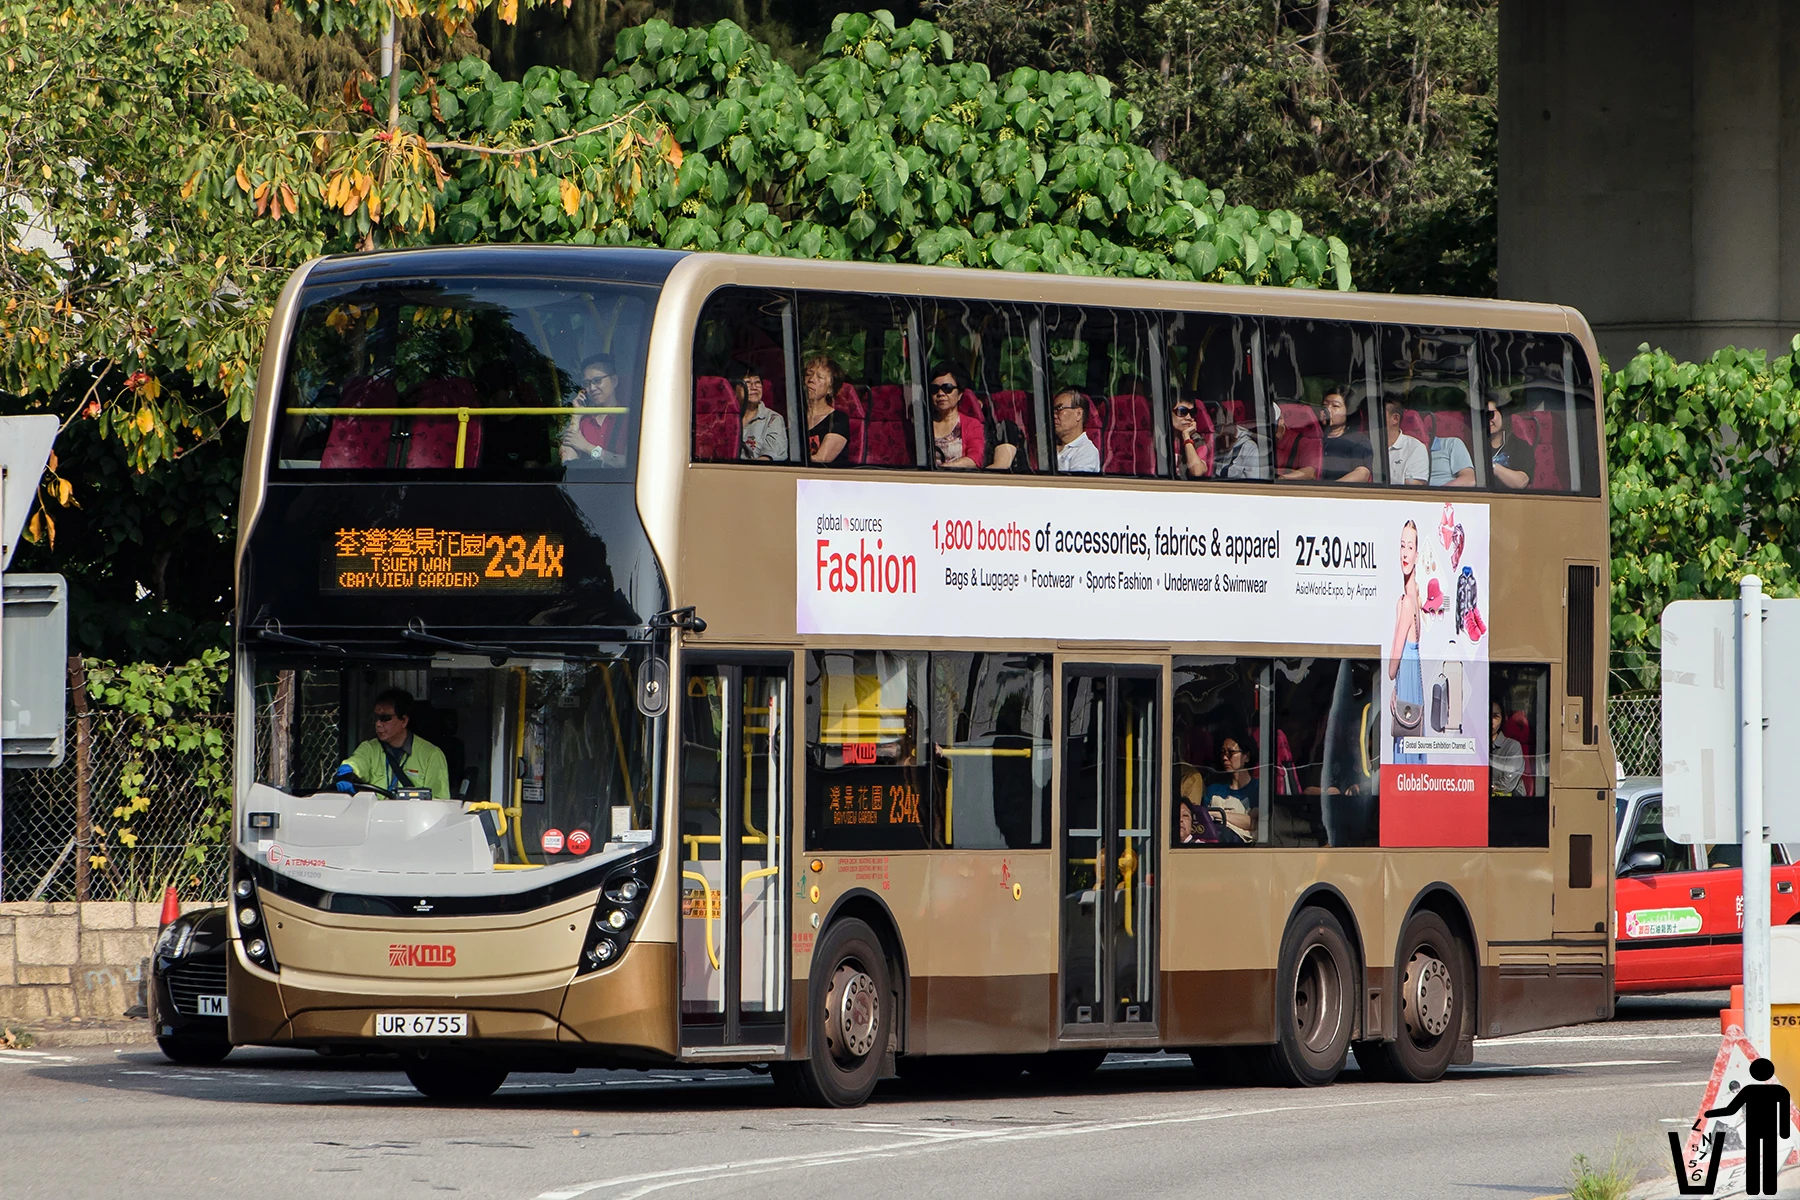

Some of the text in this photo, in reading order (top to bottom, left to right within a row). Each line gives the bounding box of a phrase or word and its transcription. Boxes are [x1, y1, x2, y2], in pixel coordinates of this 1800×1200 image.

[816, 513, 883, 535] global sources
[335, 528, 486, 557] 荃灣灣景花園
[932, 519, 1281, 565] 1,800 booths of accessories, fabrics & apparel
[1295, 535, 1377, 570] 27-30 APRIL
[371, 557, 451, 572] TSUEN WAN
[816, 538, 917, 594] Fashion
[339, 572, 480, 588] (BAYVIEW GARDEN)
[945, 568, 1268, 594] Bags & Luggage Footwear Sports Fashion Underwear & Swimwear
[1295, 581, 1377, 601] AsiaWorld-Expo, by Airport
[852, 742, 877, 764] KMB
[1405, 741, 1467, 750] Global Sources Exhibition Channel
[1397, 773, 1475, 792] GlobalSources.com
[408, 945, 457, 967] KMB
[200, 997, 222, 1013] TM
[383, 1016, 461, 1033] UR 6755
